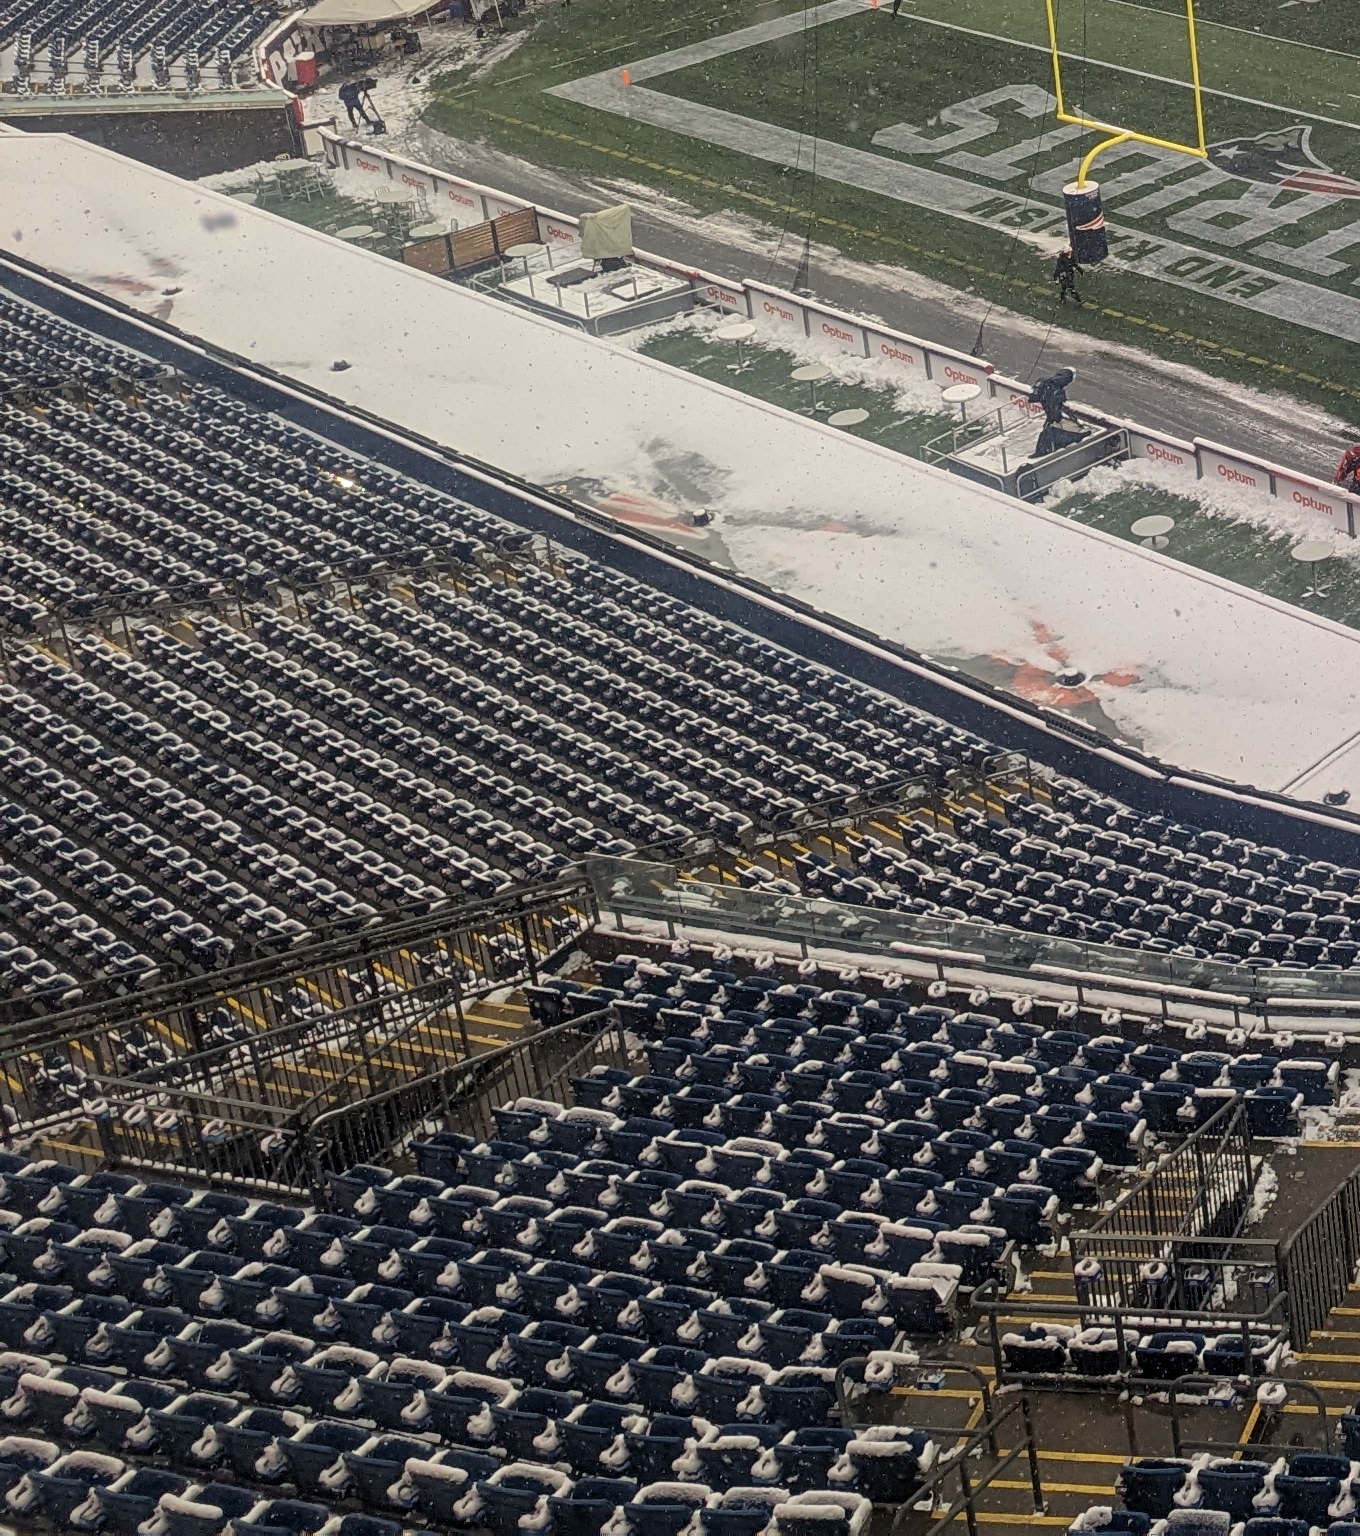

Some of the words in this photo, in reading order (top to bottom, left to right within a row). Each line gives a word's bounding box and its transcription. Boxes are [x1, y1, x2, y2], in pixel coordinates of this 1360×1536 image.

[448, 190, 475, 209] Optum
[546, 224, 575, 244] Optum
[1163, 255, 1281, 300] END
[706, 286, 738, 306] Optum
[821, 322, 855, 344] Optum
[880, 343, 915, 365] Optum
[943, 366, 979, 387] Optum
[1145, 442, 1184, 466] Optum
[1217, 464, 1257, 488] Optum
[1292, 490, 1334, 516] Optum
